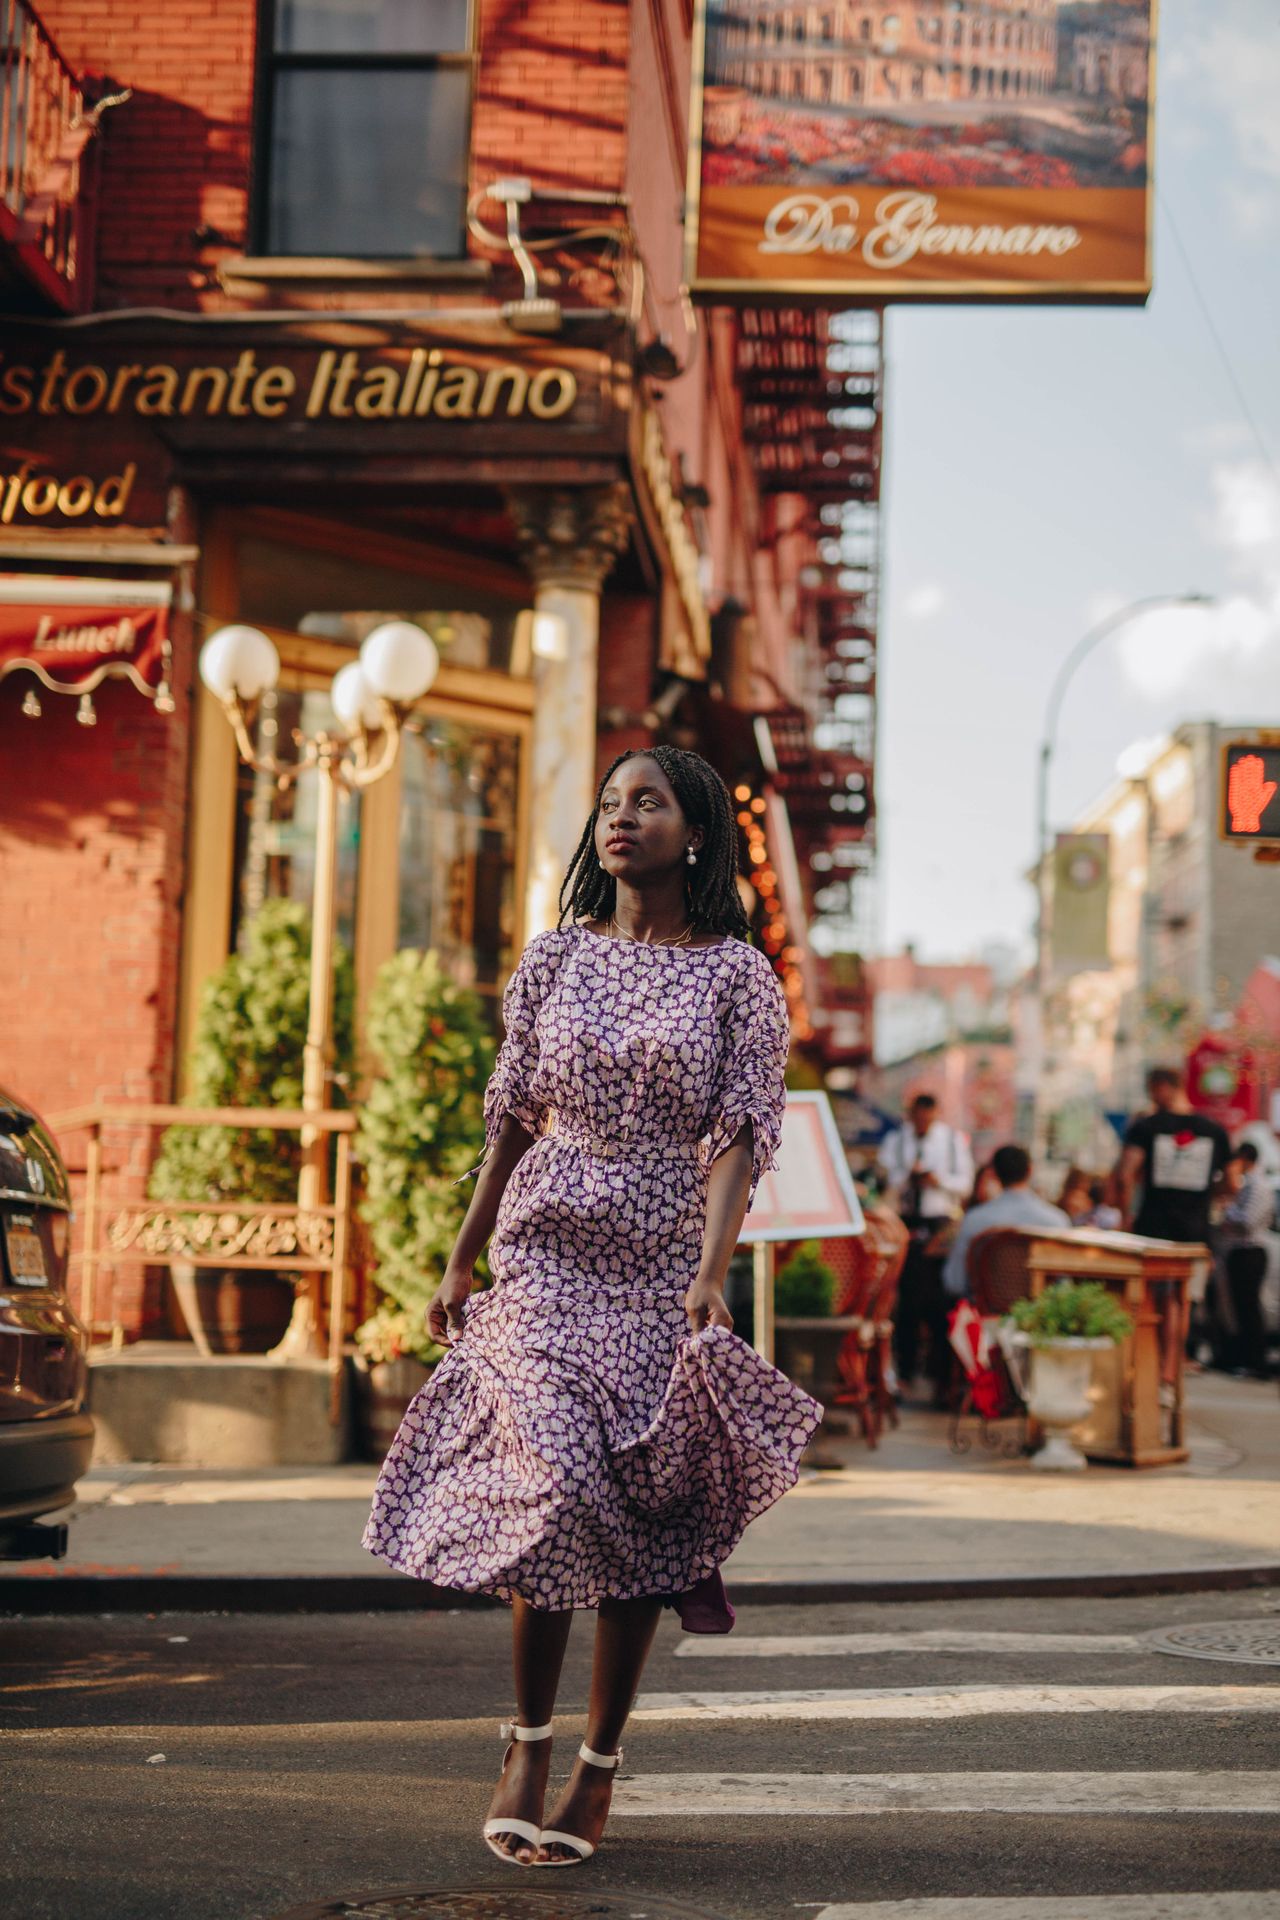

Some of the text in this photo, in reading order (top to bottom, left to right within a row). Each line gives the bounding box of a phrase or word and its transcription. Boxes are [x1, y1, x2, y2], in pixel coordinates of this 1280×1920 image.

[757, 190, 1082, 270] Da Gennaro
[0, 348, 578, 420] storante Italiano
[0, 461, 137, 524] food
[33, 614, 137, 654] Lunch
